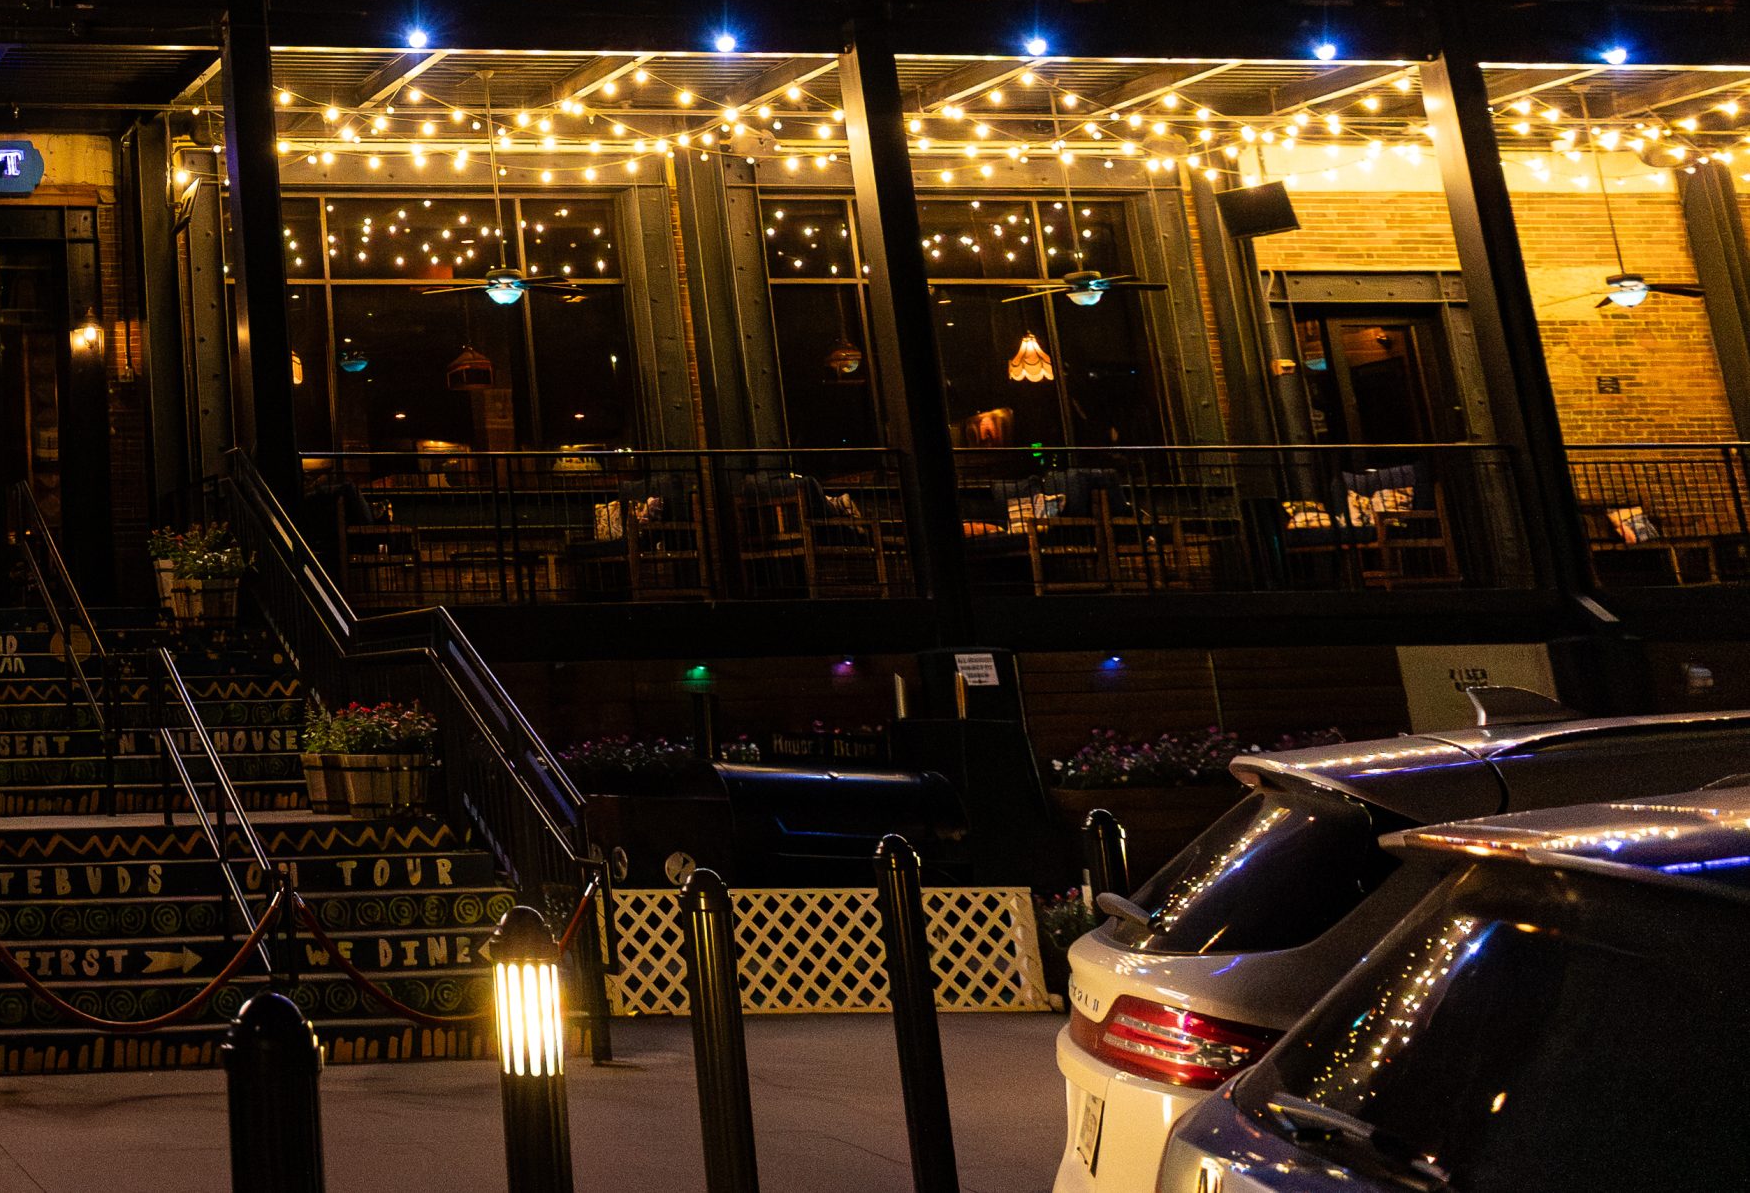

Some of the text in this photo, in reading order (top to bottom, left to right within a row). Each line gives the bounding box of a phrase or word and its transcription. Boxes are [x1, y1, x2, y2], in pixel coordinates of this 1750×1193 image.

[0, 733, 70, 757] SEAT
[213, 729, 298, 752] HOUSE
[246, 861, 299, 890] ON
[336, 858, 453, 887] TOUR
[15, 949, 128, 977] FIRST
[305, 940, 354, 967] WE
[378, 936, 471, 968] DINE
